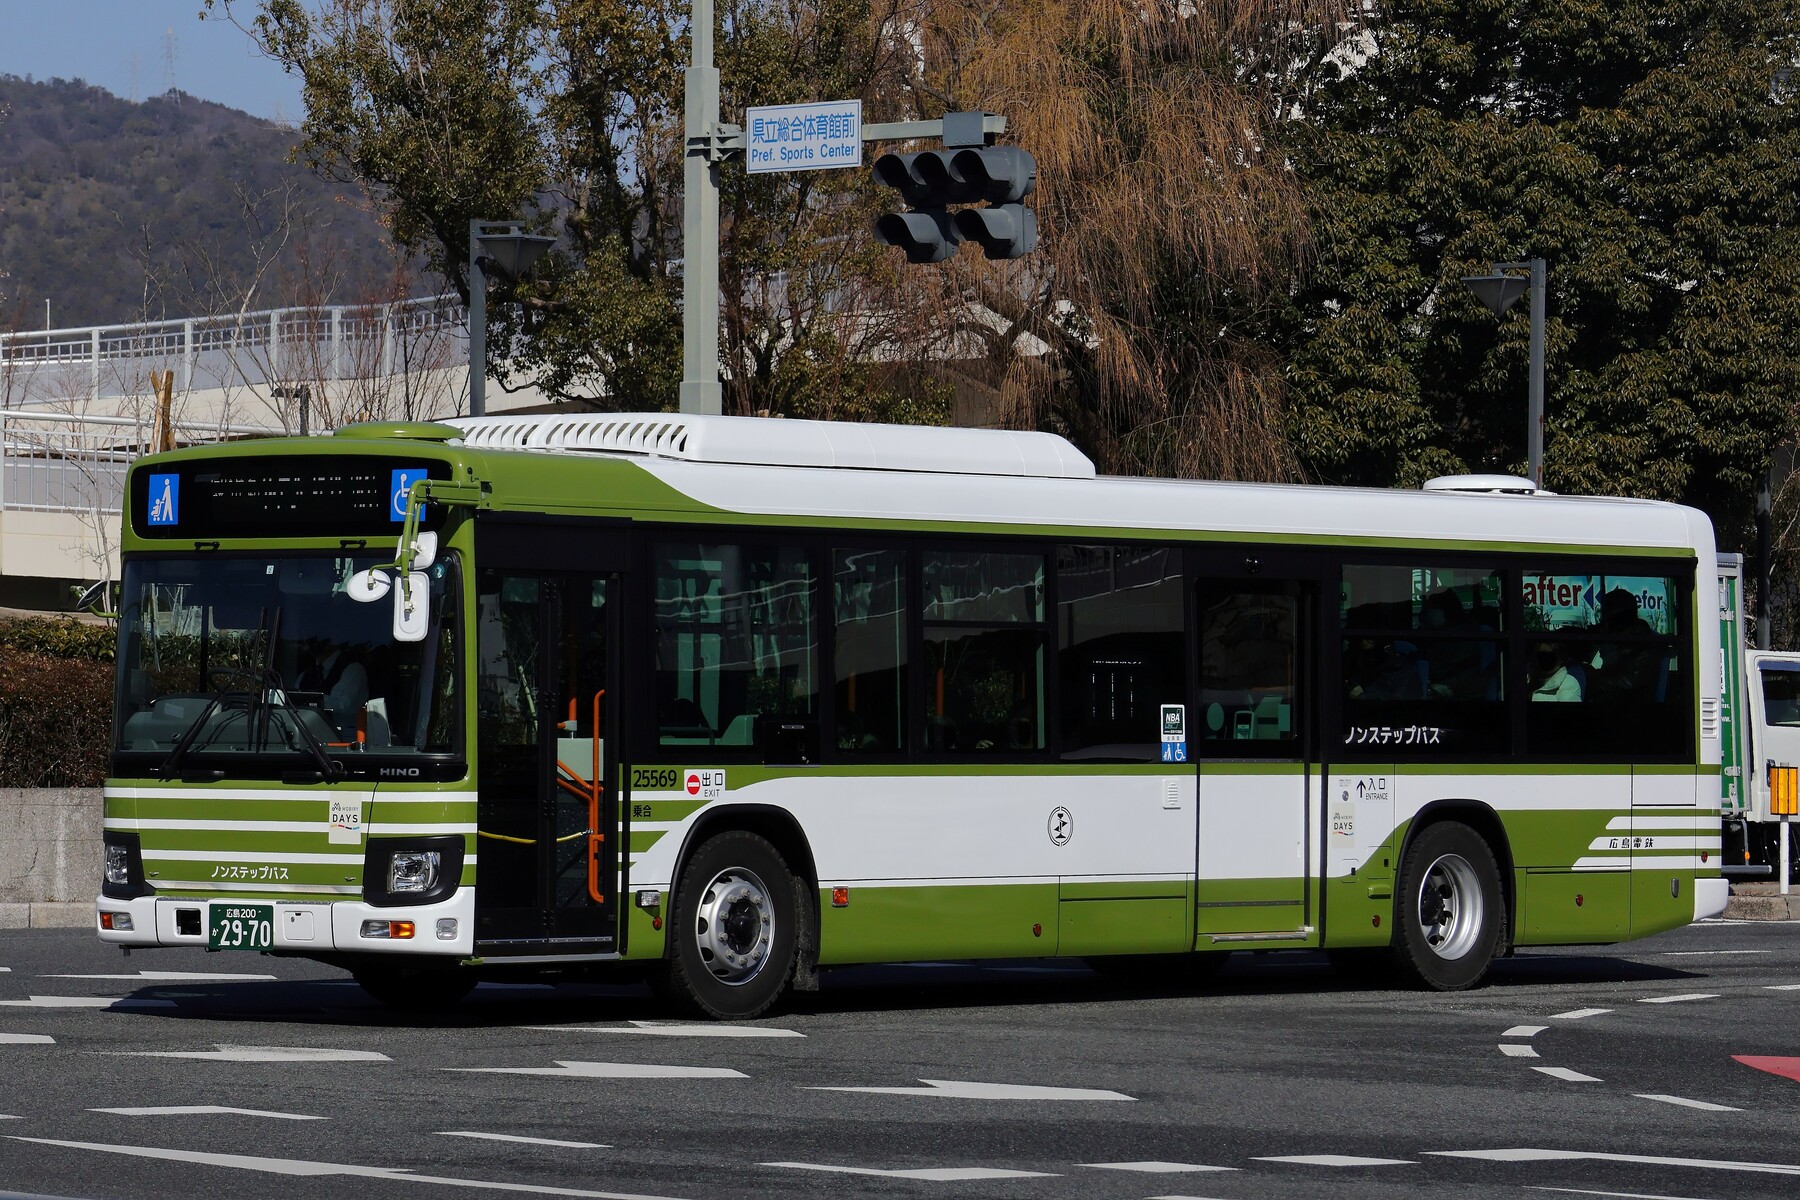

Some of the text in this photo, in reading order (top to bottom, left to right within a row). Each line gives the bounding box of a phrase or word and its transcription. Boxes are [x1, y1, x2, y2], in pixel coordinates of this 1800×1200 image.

[752, 111, 855, 144] 県立総合体育館前
[752, 142, 855, 163] Pref. Sports Center
[1523, 576, 1582, 606] after
[1634, 590, 1663, 609] efor
[1165, 712, 1180, 722] NBA
[1345, 725, 1440, 744] ノンステップバス
[380, 767, 420, 776] HINO
[633, 769, 677, 788] 25569
[702, 772, 723, 787] 出口
[1368, 777, 1386, 791] 入口
[704, 789, 720, 797] EXIT
[1365, 792, 1388, 800] ENTRANCE
[633, 804, 652, 818] 乗合
[332, 814, 358, 823] DAYS
[1333, 822, 1353, 830] DAYS
[211, 865, 289, 879] ノンステップバス
